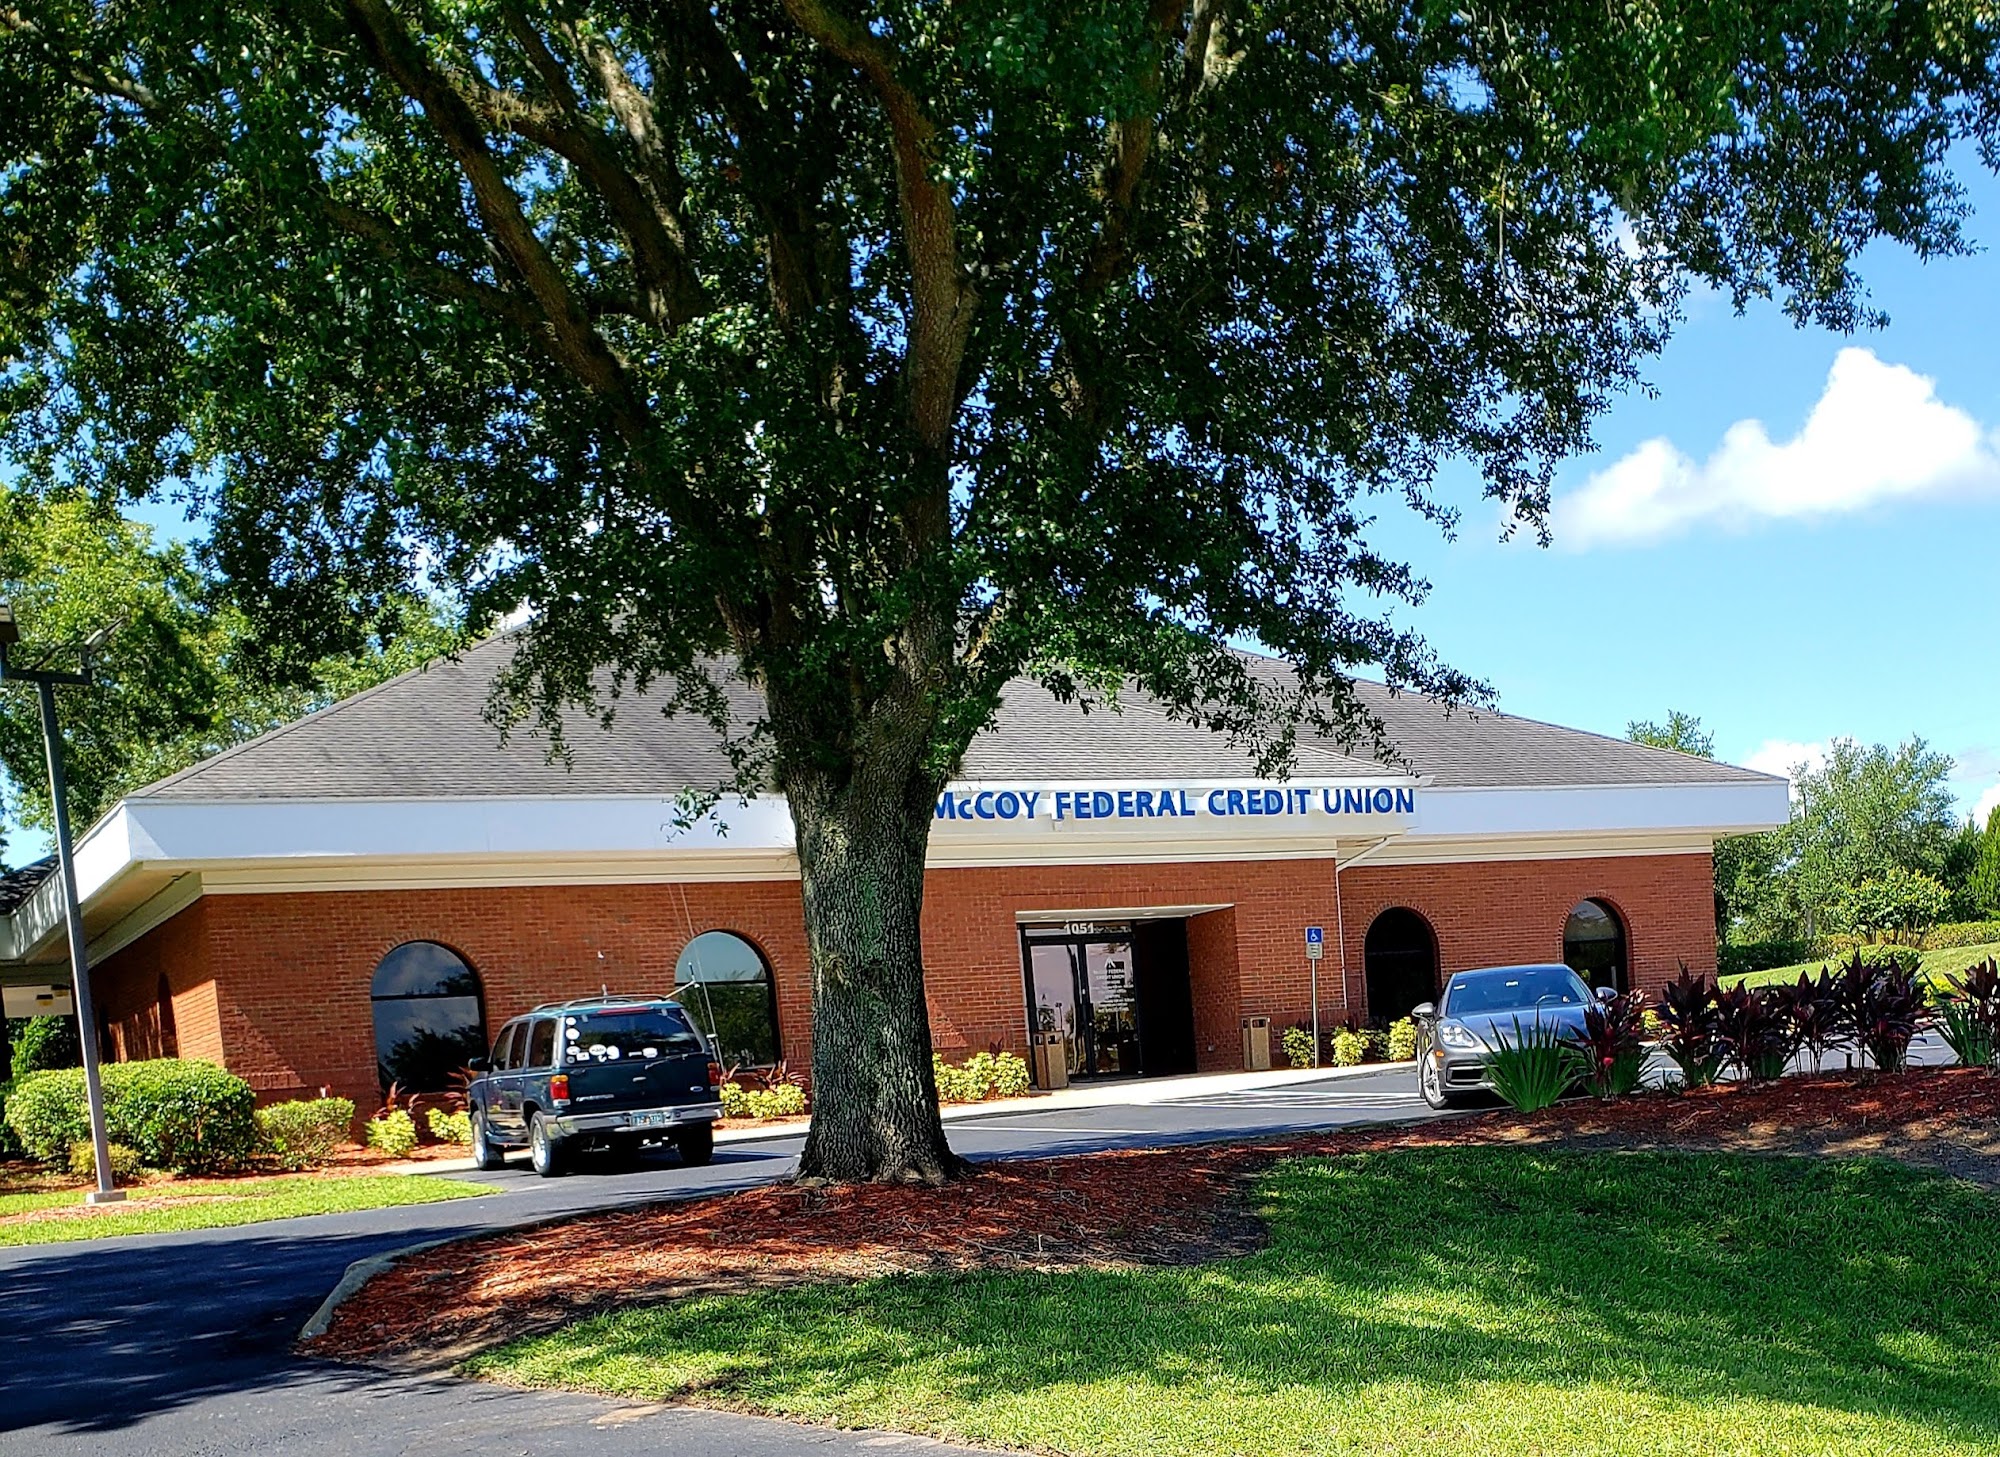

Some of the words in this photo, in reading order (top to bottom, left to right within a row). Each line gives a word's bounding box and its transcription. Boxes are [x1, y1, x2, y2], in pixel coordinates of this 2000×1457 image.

[933, 791, 1040, 820] McCOY
[1056, 790, 1195, 819] FEDERAL
[1208, 789, 1310, 816] CREDIT
[1323, 788, 1414, 815] UNION
[1063, 922, 1094, 935] 1051
